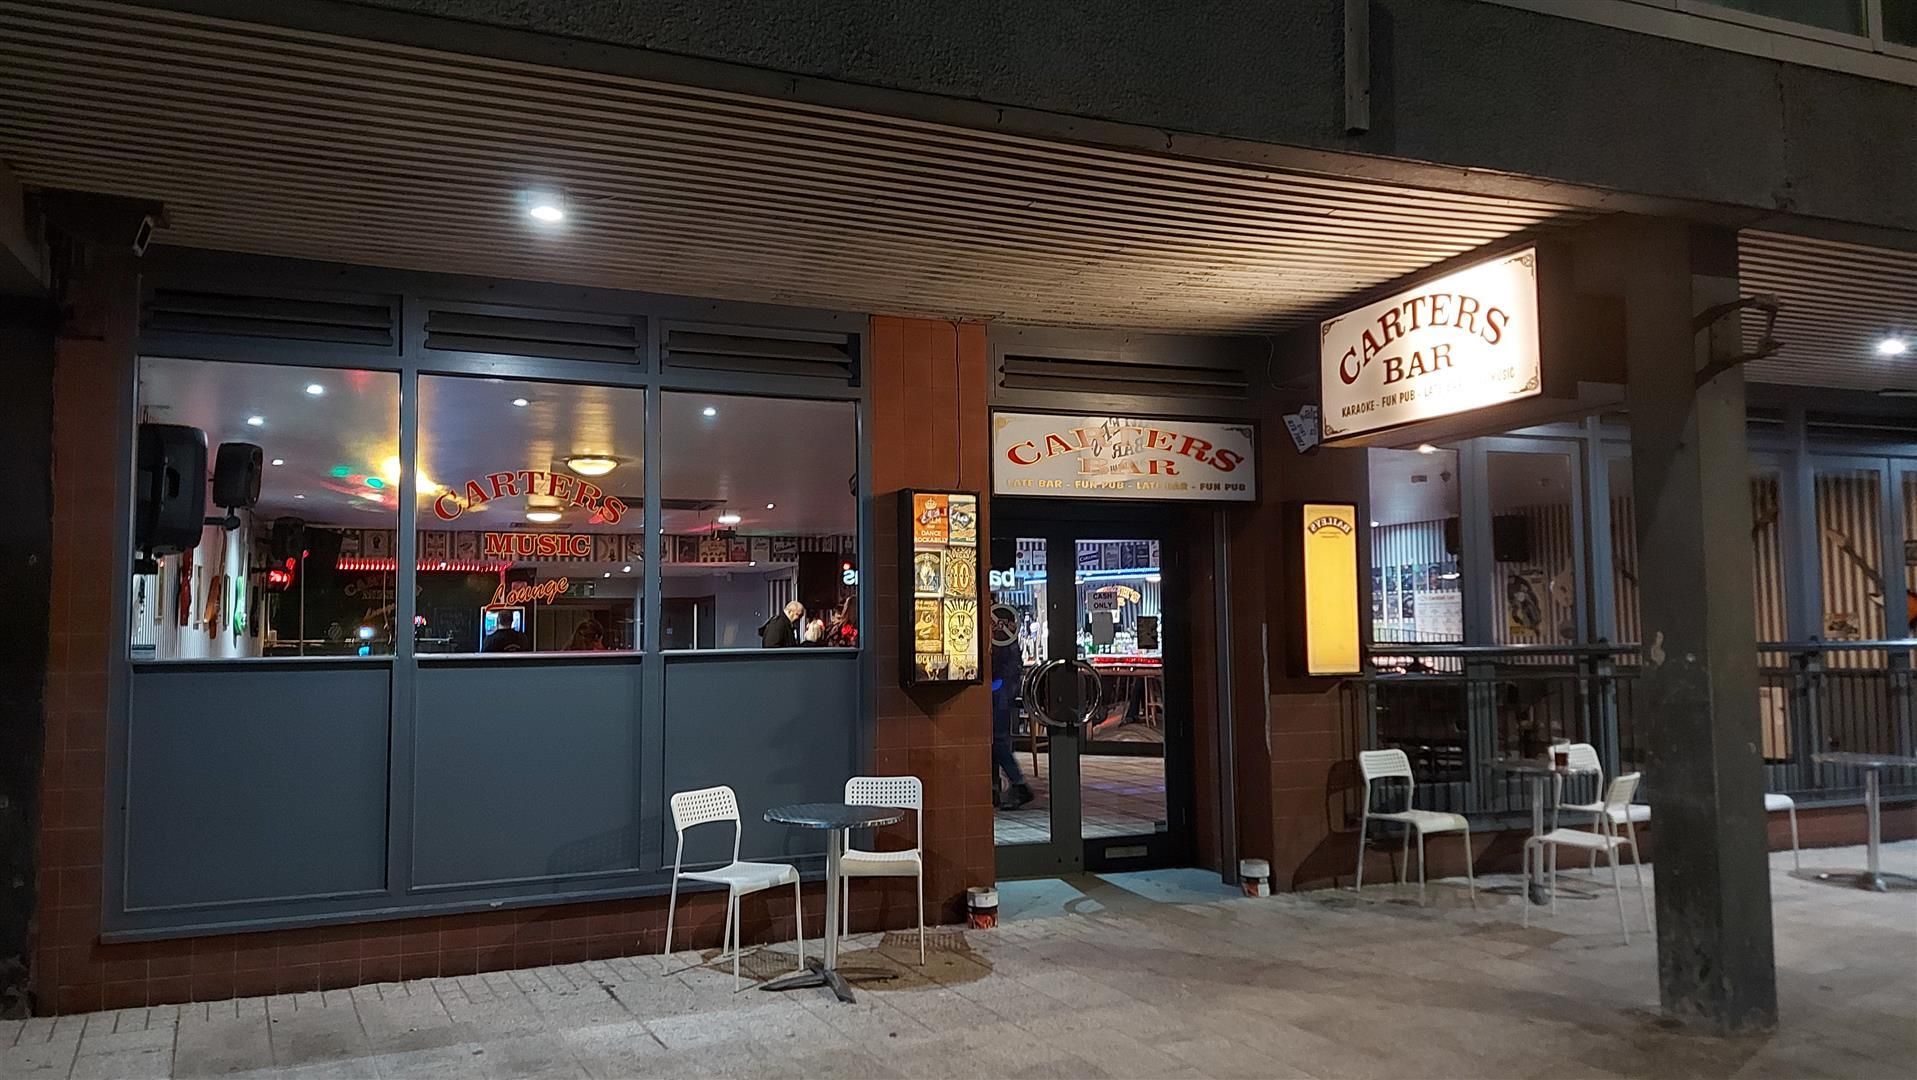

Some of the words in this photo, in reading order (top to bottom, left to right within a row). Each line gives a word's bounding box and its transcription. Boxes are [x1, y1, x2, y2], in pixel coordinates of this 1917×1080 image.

[1338, 293, 1511, 385] CARTERS
[1383, 343, 1454, 385] BAR
[1341, 400, 1375, 418] KARAOKE
[1382, 393, 1397, 408] FUN
[1399, 390, 1415, 404] PUB
[1007, 427, 1245, 473] CARTERS
[1078, 457, 1180, 475] BAR
[433, 470, 628, 525] CARTERS
[1038, 479, 1063, 489] BAR
[1074, 480, 1097, 489] FUN
[1101, 481, 1125, 490] PUB
[1136, 481, 1160, 490] LAT
[1199, 482, 1220, 491] FUN
[1224, 483, 1246, 491] PUB
[485, 533, 591, 556] MUSIC
[486, 577, 569, 612] Lounge
[945, 599, 977, 613] LUCKY
[1093, 592, 1113, 600] CASH
